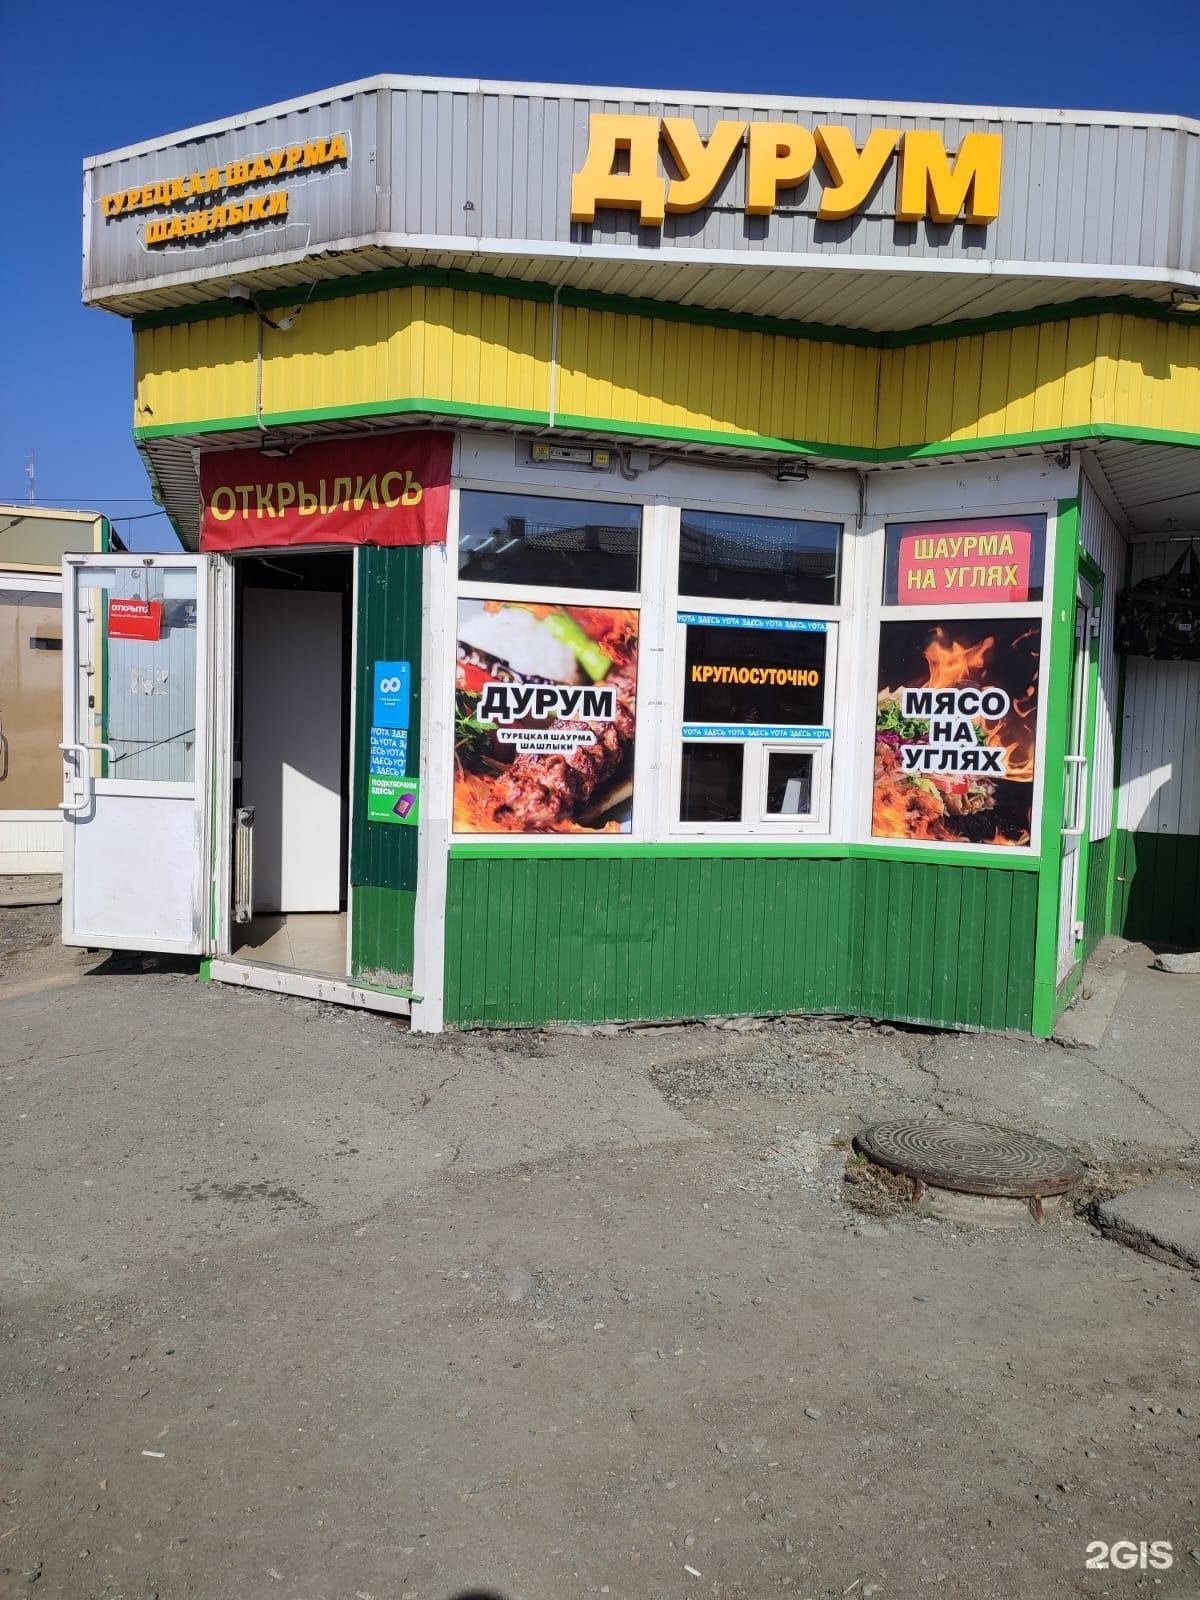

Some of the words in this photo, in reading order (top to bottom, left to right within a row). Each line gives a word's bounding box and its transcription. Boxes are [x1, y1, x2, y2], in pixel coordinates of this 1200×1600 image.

[101, 168, 221, 218] ТУРЕЦКАЯ
[225, 134, 348, 186] ШАУРМА
[571, 113, 1002, 227] ДУРУМ
[145, 189, 289, 244] ШАШЛЫКИ
[210, 470, 424, 521] ОТКРЫЛИСЬ
[914, 534, 1014, 560] ШАУРМА
[907, 568, 937, 590] НА
[944, 564, 1019, 589] УГЛЯХ
[111, 604, 148, 613] ОТКРЫТО
[698, 616, 720, 624] ЗДЕСЬ
[742, 619, 764, 627] ЗДЕСЬ
[785, 621, 806, 630] ЗДЕСЬ
[692, 665, 819, 687] КРУГЛОСУТОЧНО
[481, 686, 613, 720] ДУРУМ
[906, 692, 1005, 716] МЯСО
[501, 732, 549, 741] ТУРЕЦКАЯ
[684, 728, 701, 736] YOTA
[704, 728, 726, 737] ЗДЕСЬ
[728, 729, 745, 737] YOTA
[747, 730, 769, 738] ЗДЕСЬ
[771, 730, 788, 738] YOTA
[790, 731, 811, 739] ЗДЕСЬ
[813, 731, 830, 739] YOTA
[933, 722, 973, 742] НА
[520, 743, 573, 751] ШАШЛЫКИ
[905, 748, 1002, 772] УГЛЯХ
